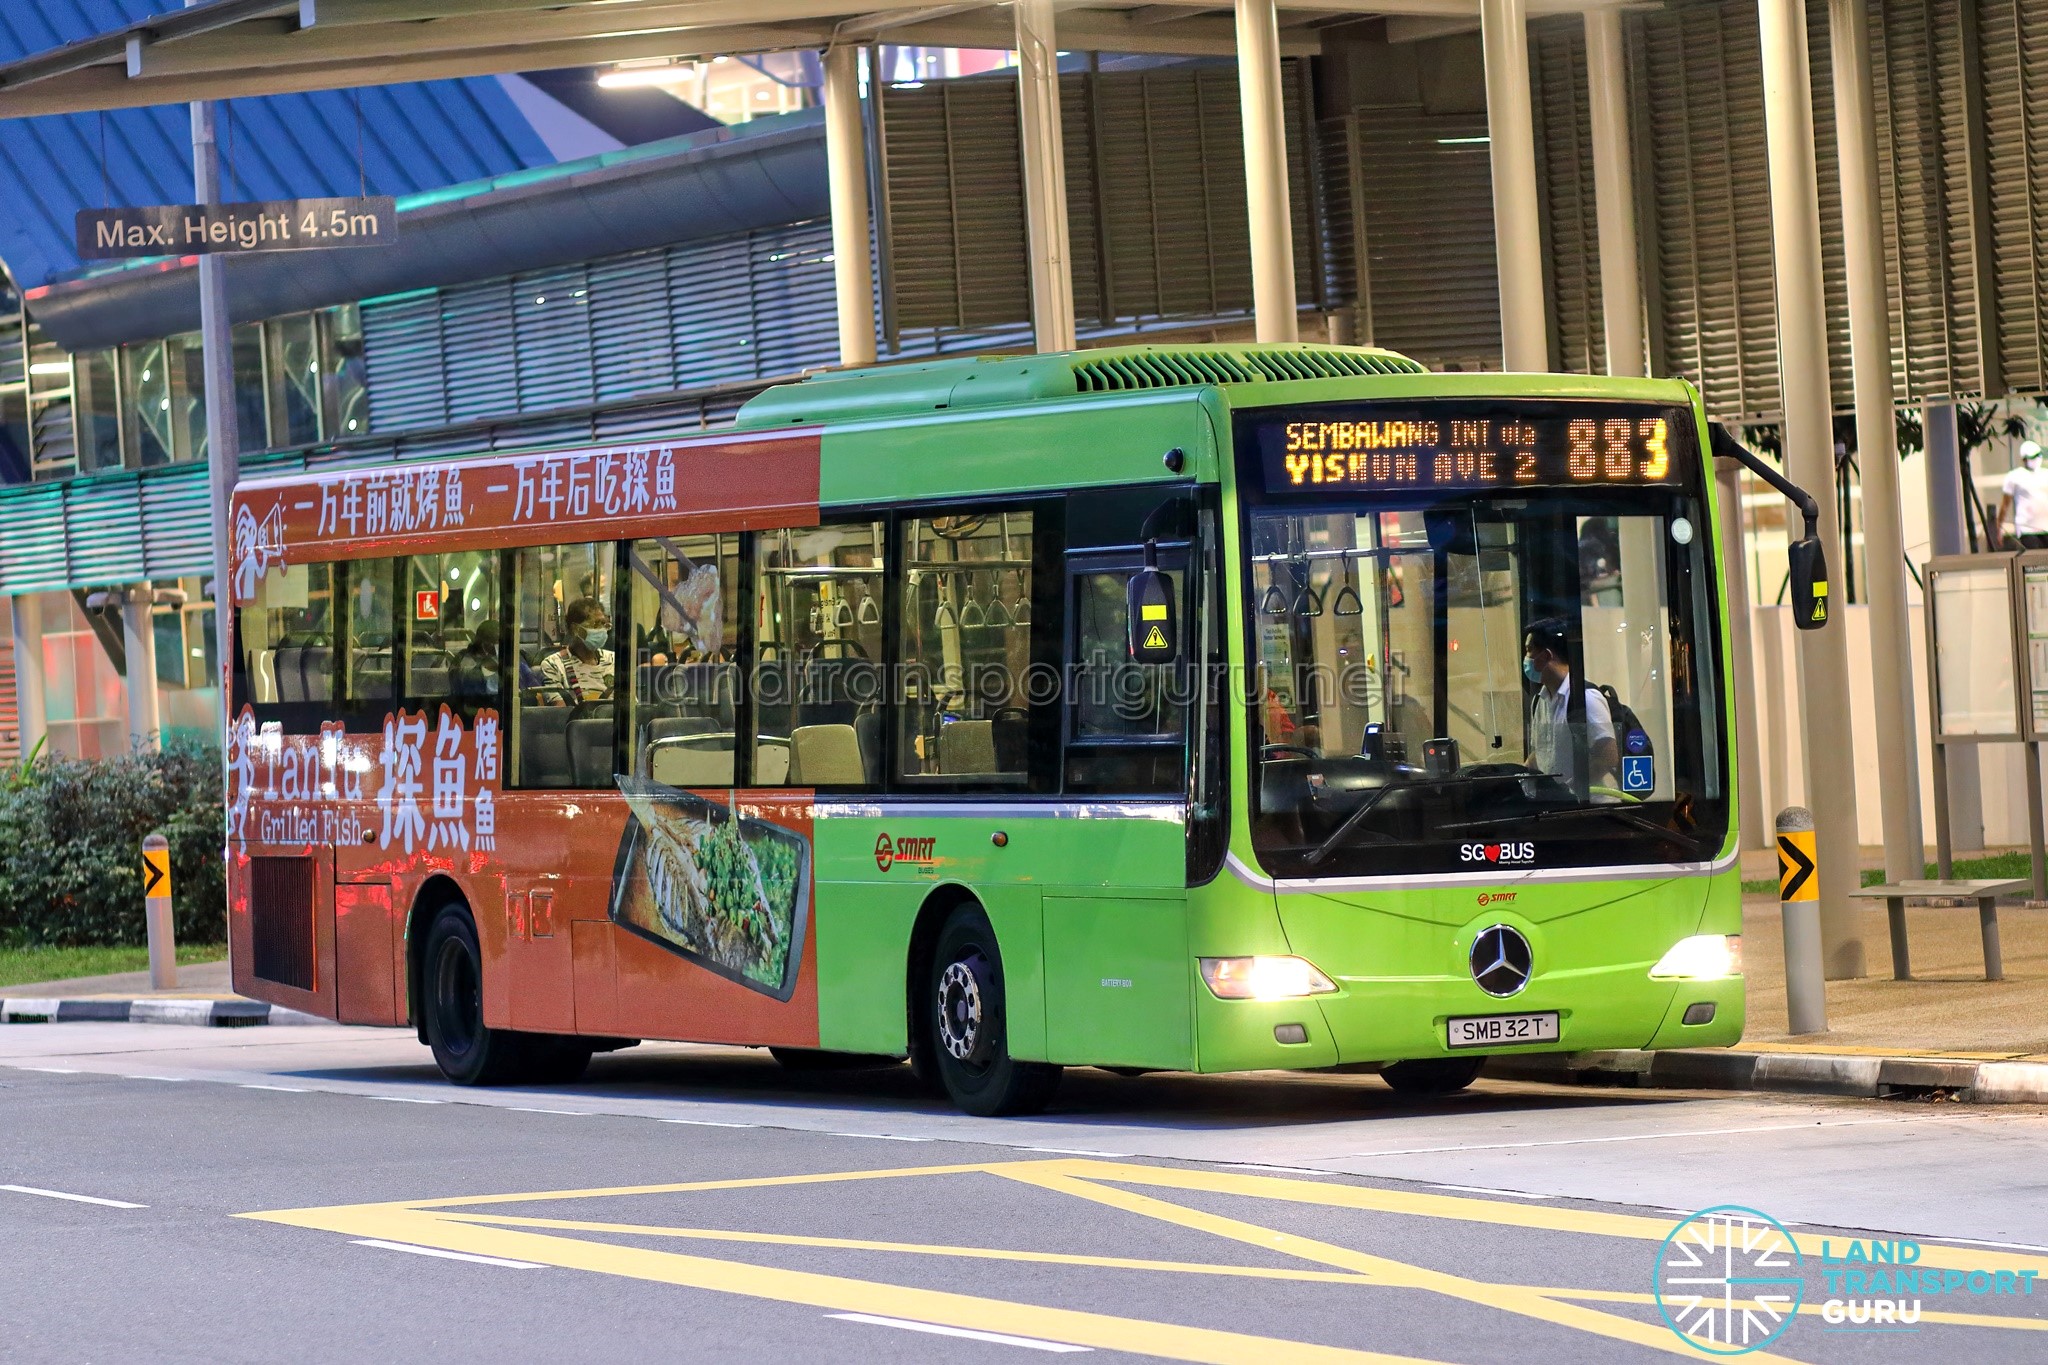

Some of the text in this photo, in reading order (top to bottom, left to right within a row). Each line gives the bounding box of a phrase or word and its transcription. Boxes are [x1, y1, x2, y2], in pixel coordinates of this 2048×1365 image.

[96, 209, 378, 248] Max. Height 4.5m
[1285, 419, 1535, 451] SEMBAWANG INT via
[1568, 418, 1668, 479] 883
[1285, 452, 1536, 484] YISHUN AVE 2
[377, 712, 469, 855] 探魚
[260, 807, 363, 846] Grilled Fish
[894, 837, 936, 860] SMRT
[1490, 892, 1517, 902] SMRT
[1463, 1020, 1501, 1041] SMB
